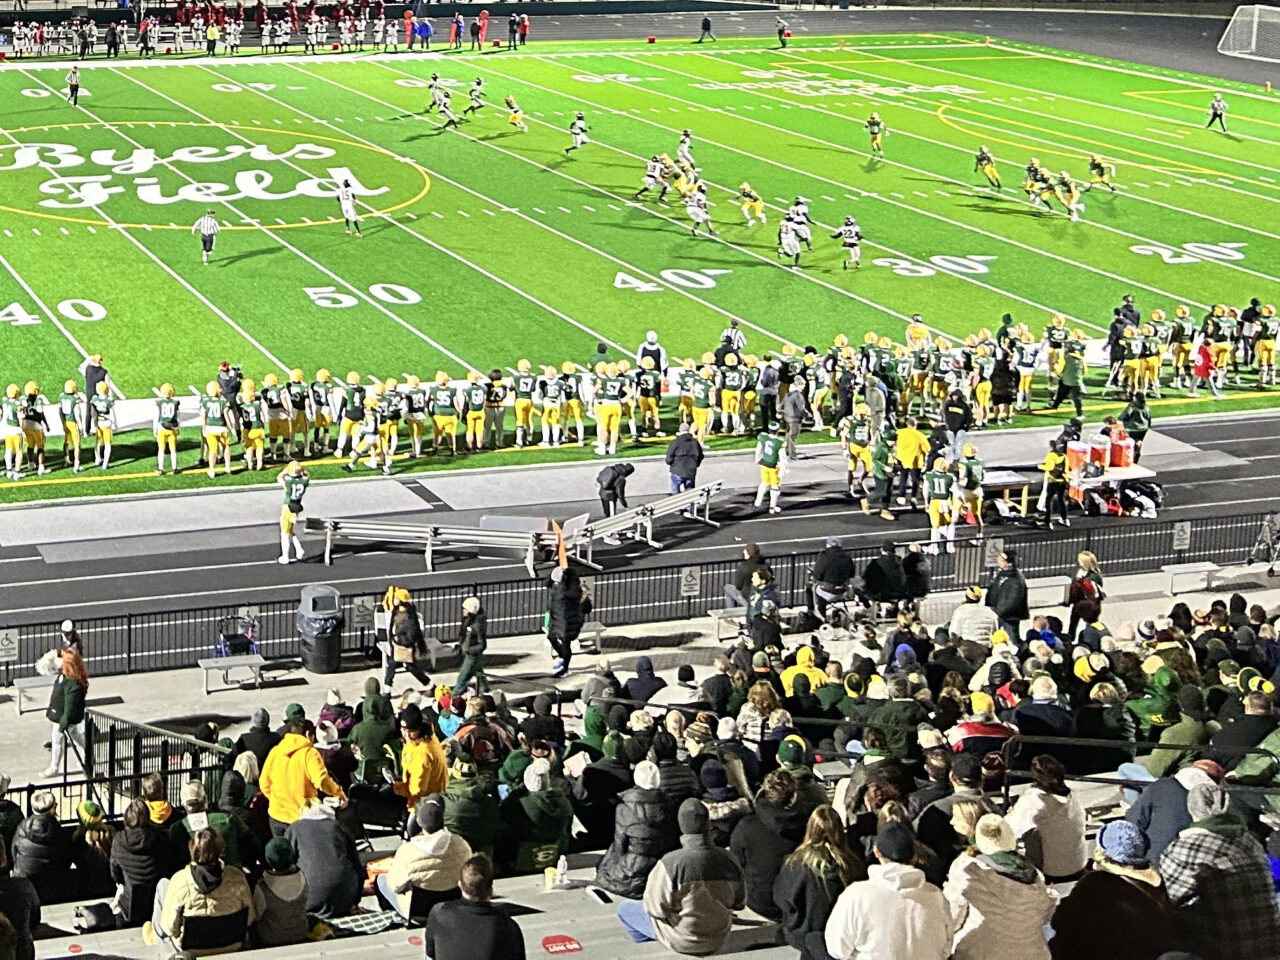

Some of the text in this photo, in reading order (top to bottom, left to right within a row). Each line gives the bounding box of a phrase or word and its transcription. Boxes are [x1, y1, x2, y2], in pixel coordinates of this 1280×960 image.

[38, 166, 390, 208] Field
[291, 483, 304, 500] 12
[933, 478, 946, 494] 11
